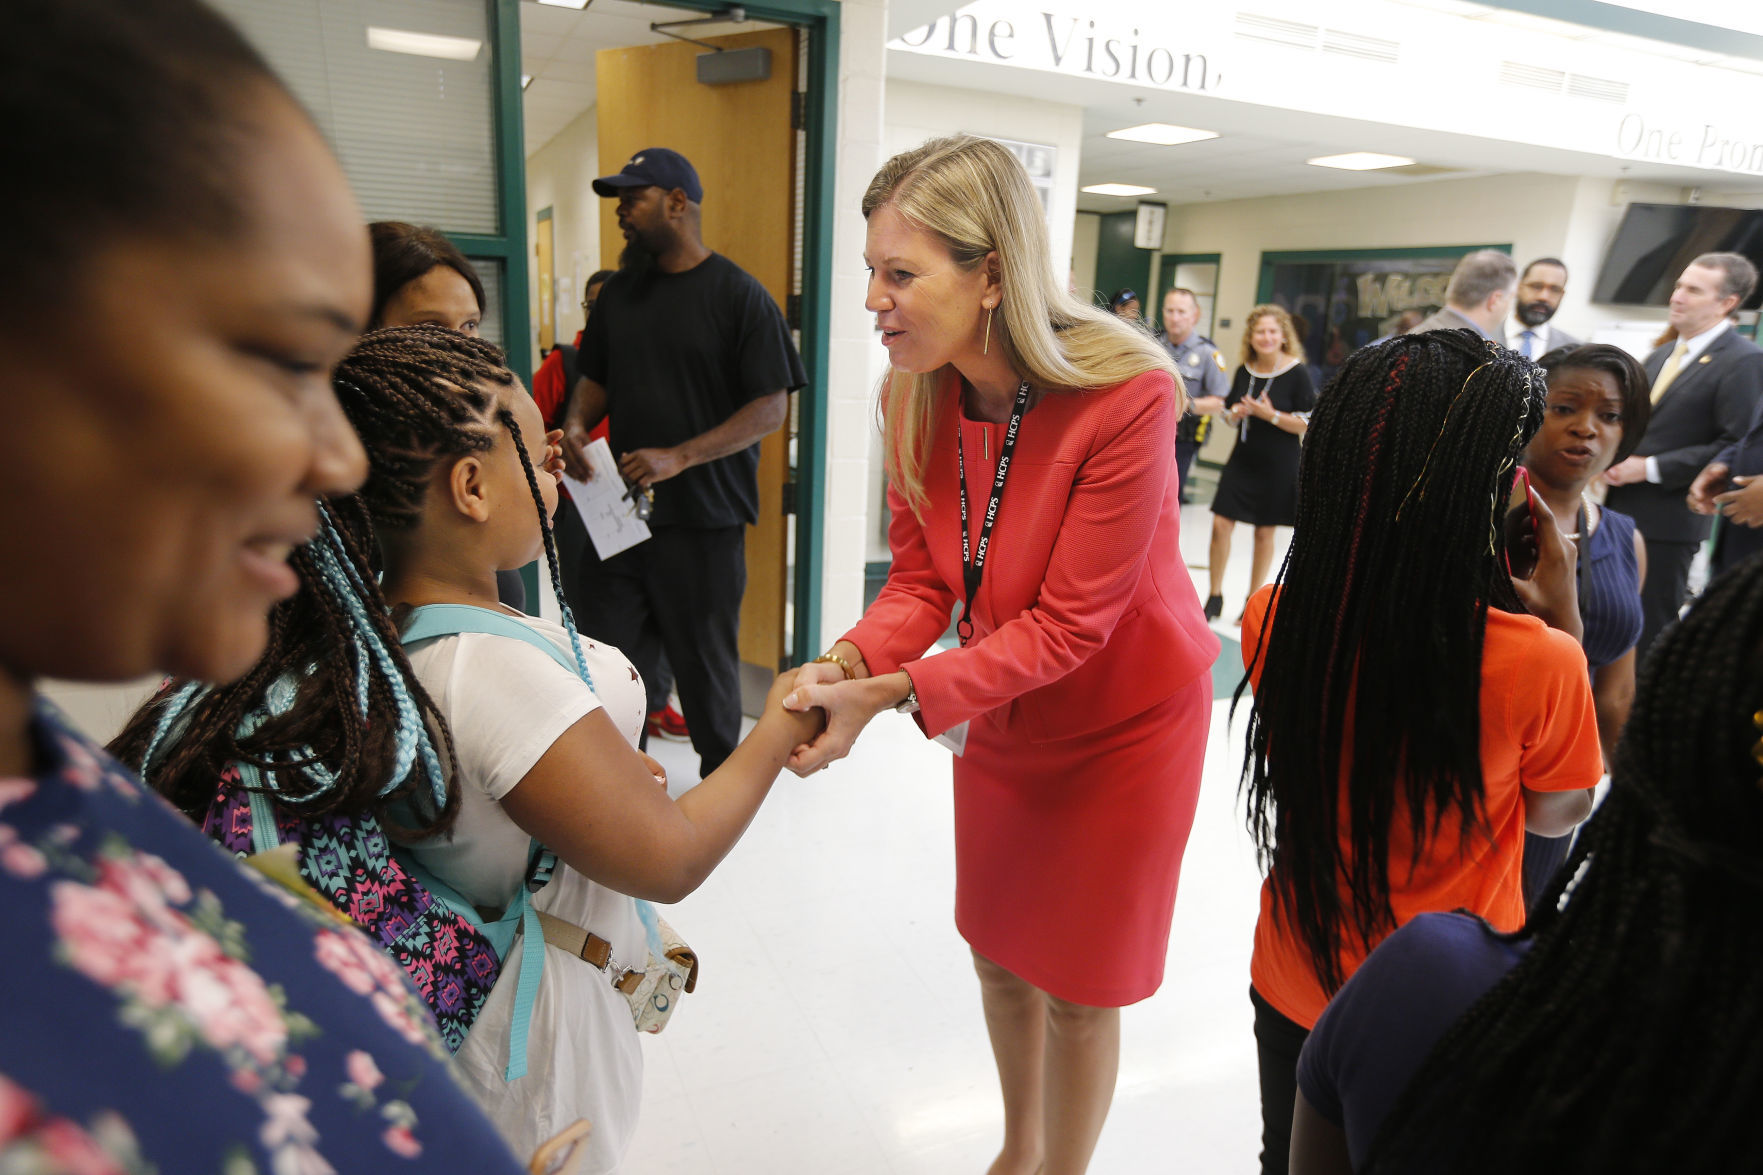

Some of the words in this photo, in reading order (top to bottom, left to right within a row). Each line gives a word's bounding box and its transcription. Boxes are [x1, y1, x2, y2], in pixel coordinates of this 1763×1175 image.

[1041, 12, 1222, 90] Vision,
[1617, 113, 1682, 160] One
[1019, 381, 1029, 396] HC
[1007, 414, 1020, 438] HCPS
[997, 456, 1009, 480] HCPS
[986, 497, 999, 520] HCPS
[977, 537, 988, 559] HCPS
